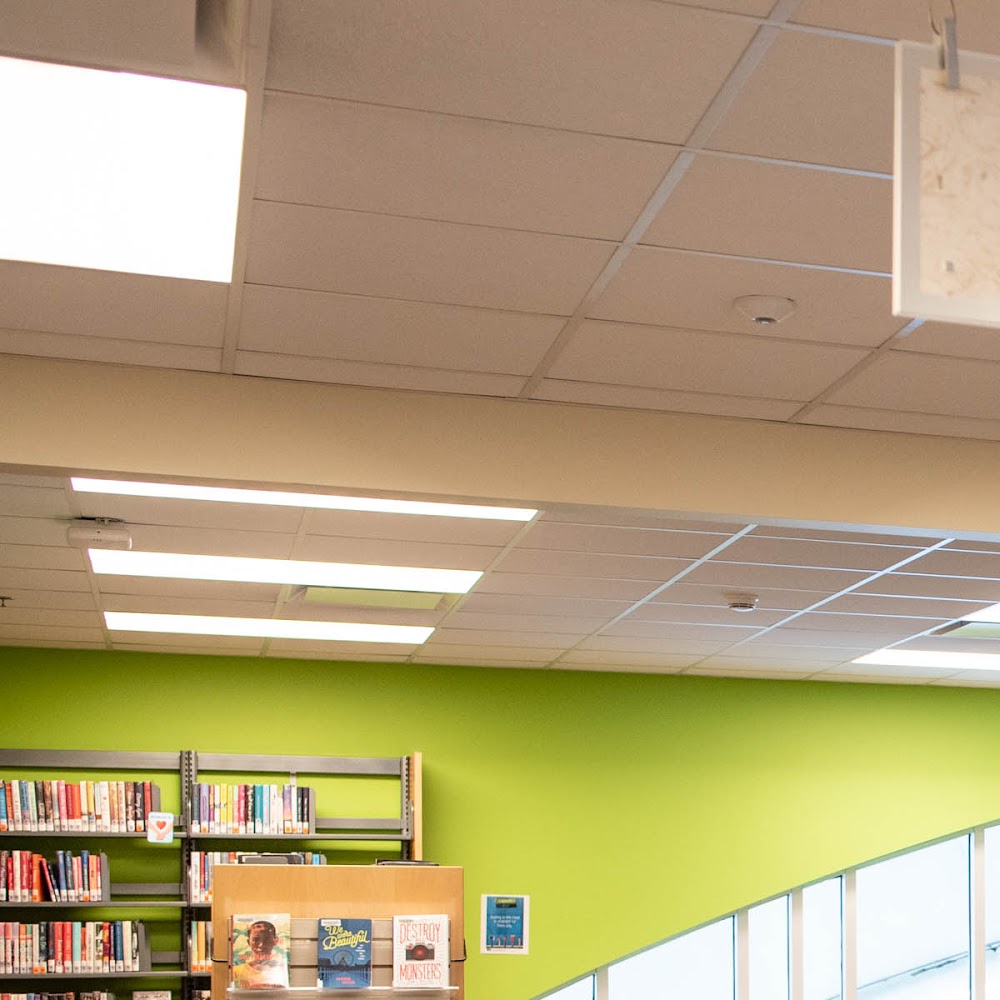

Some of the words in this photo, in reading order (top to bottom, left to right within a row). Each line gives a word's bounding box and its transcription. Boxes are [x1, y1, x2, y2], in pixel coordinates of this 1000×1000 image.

[323, 930, 370, 950] Beautiful
[400, 924, 440, 943] DESTROY
[400, 963, 442, 980] MONSTERS
